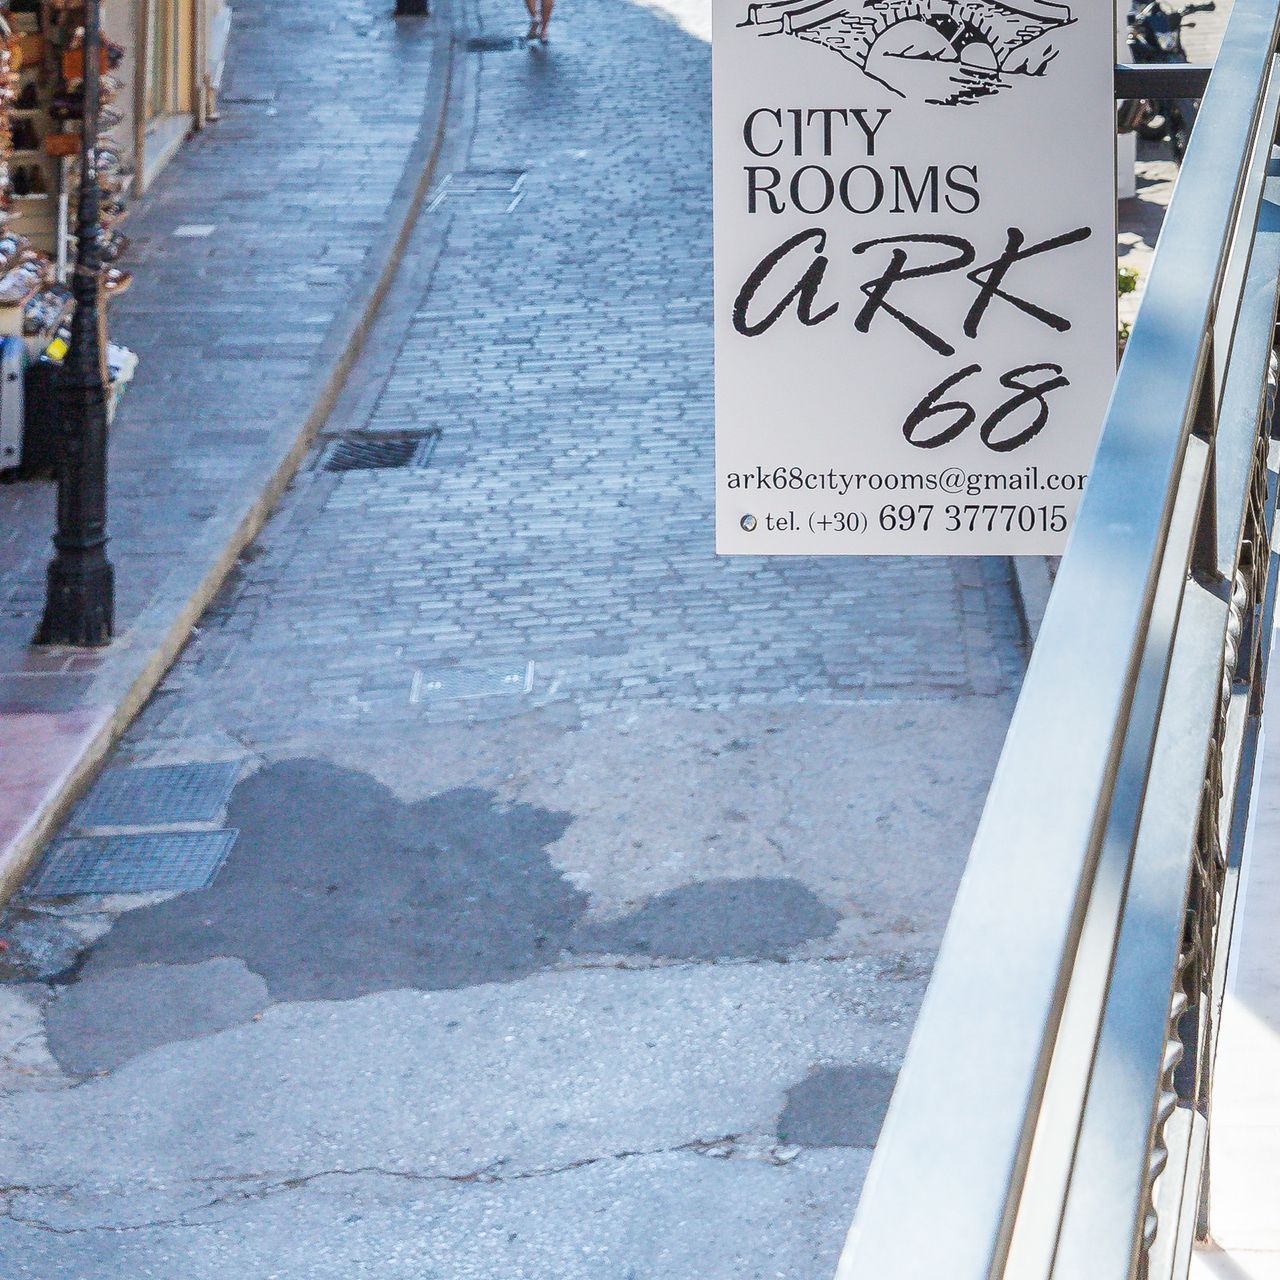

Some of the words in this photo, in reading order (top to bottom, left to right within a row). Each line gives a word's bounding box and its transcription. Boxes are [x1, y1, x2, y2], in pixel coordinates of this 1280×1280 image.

[743, 107, 892, 158] CITY
[743, 164, 981, 215] ROOMS
[902, 362, 1071, 453] 68
[765, 510, 800, 531] tel.
[808, 511, 868, 534] (+30)
[879, 504, 935, 532] 697
[945, 504, 1068, 533] 3777015
